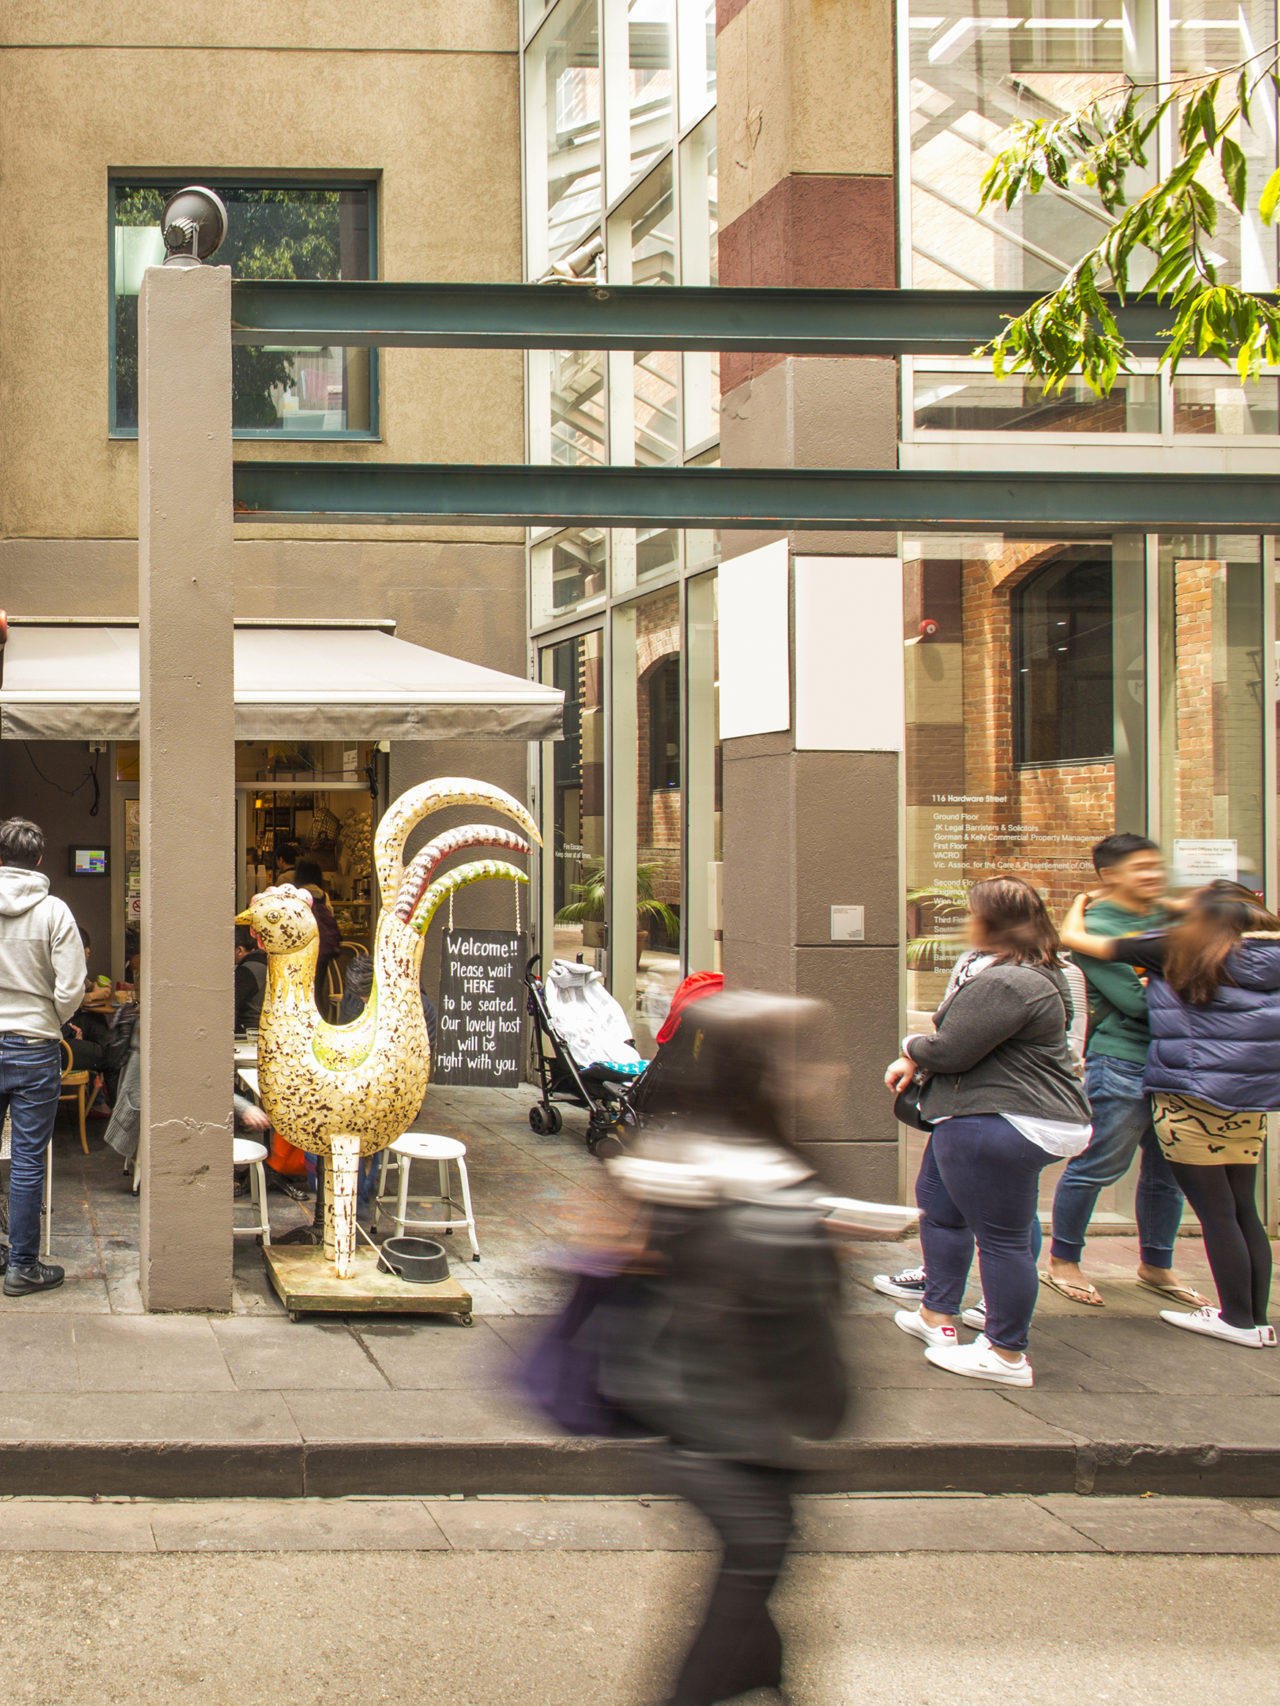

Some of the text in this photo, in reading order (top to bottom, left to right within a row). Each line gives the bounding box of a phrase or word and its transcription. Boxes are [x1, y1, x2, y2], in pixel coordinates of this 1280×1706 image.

[931, 794, 1007, 803] 116 Hardware Street
[933, 813, 979, 821] Ground Floor
[944, 824, 964, 832] Legal
[1008, 824, 1039, 832] Solicitors
[934, 833, 962, 841] Gorman
[964, 833, 969, 841] &
[970, 833, 987, 842] Kelly
[1030, 834, 1060, 843] Property
[933, 842, 968, 850] First Floor
[933, 851, 960, 859] VACRO
[973, 861, 983, 869] for
[984, 861, 995, 869] the
[997, 861, 1014, 869] Care
[1015, 861, 1021, 869] &
[1023, 861, 1070, 869] Resettlement
[933, 878, 960, 886] Second
[447, 937, 518, 957] Welcome!!
[450, 961, 513, 978] Please wait
[463, 979, 495, 994] HERE
[443, 995, 517, 1012] to be seated.
[441, 1016, 521, 1038] Our lovely host
[457, 1036, 496, 1051] will be
[438, 1052, 518, 1076] right with you.
